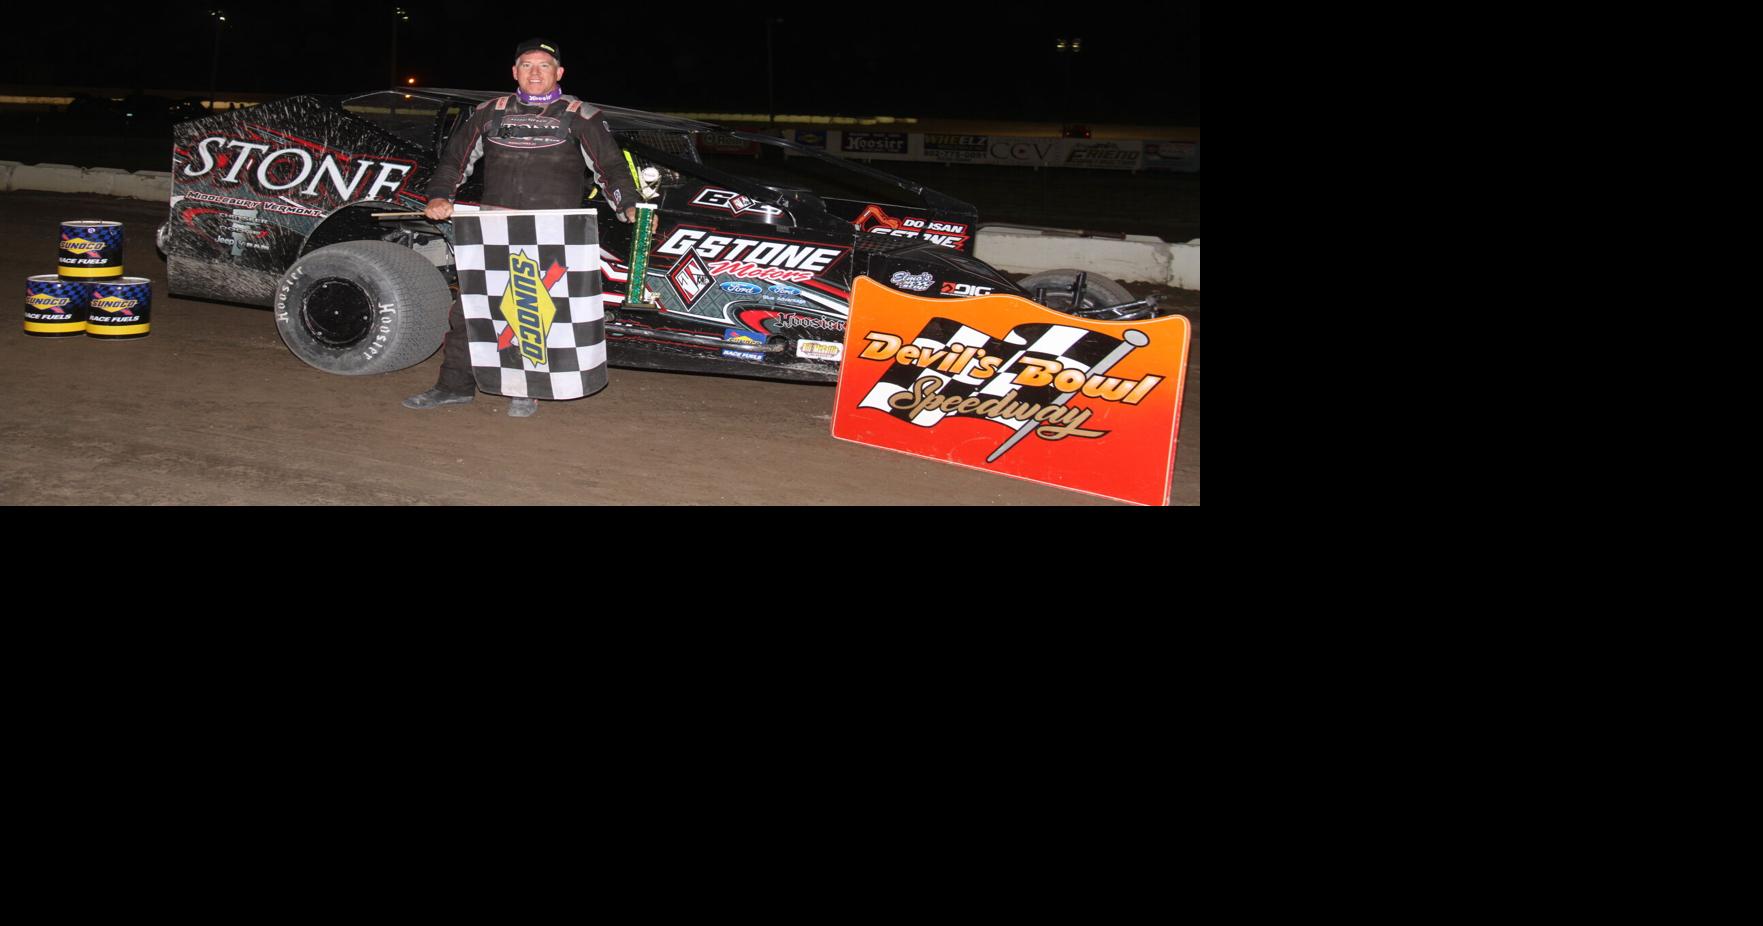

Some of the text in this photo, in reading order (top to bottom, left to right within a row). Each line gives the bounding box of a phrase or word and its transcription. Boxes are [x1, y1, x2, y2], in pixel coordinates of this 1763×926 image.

[844, 135, 905, 150] Hoosier
[184, 135, 412, 201] STONE
[60, 240, 106, 251] SUNOCO
[214, 235, 235, 246] Jeep
[871, 227, 962, 249] TNE
[657, 228, 842, 272] GSTONE
[708, 260, 815, 283] Motors
[726, 282, 755, 294] Ford
[774, 285, 800, 295] Ford
[26, 296, 70, 306] SUNOCO
[91, 300, 138, 309] SUNOCO
[513, 256, 541, 362] SUNOCO
[772, 312, 847, 331] Hoosier
[722, 350, 741, 358] RACE
[858, 331, 1166, 405] Devil's Bowl
[888, 376, 1110, 440] Speedway
